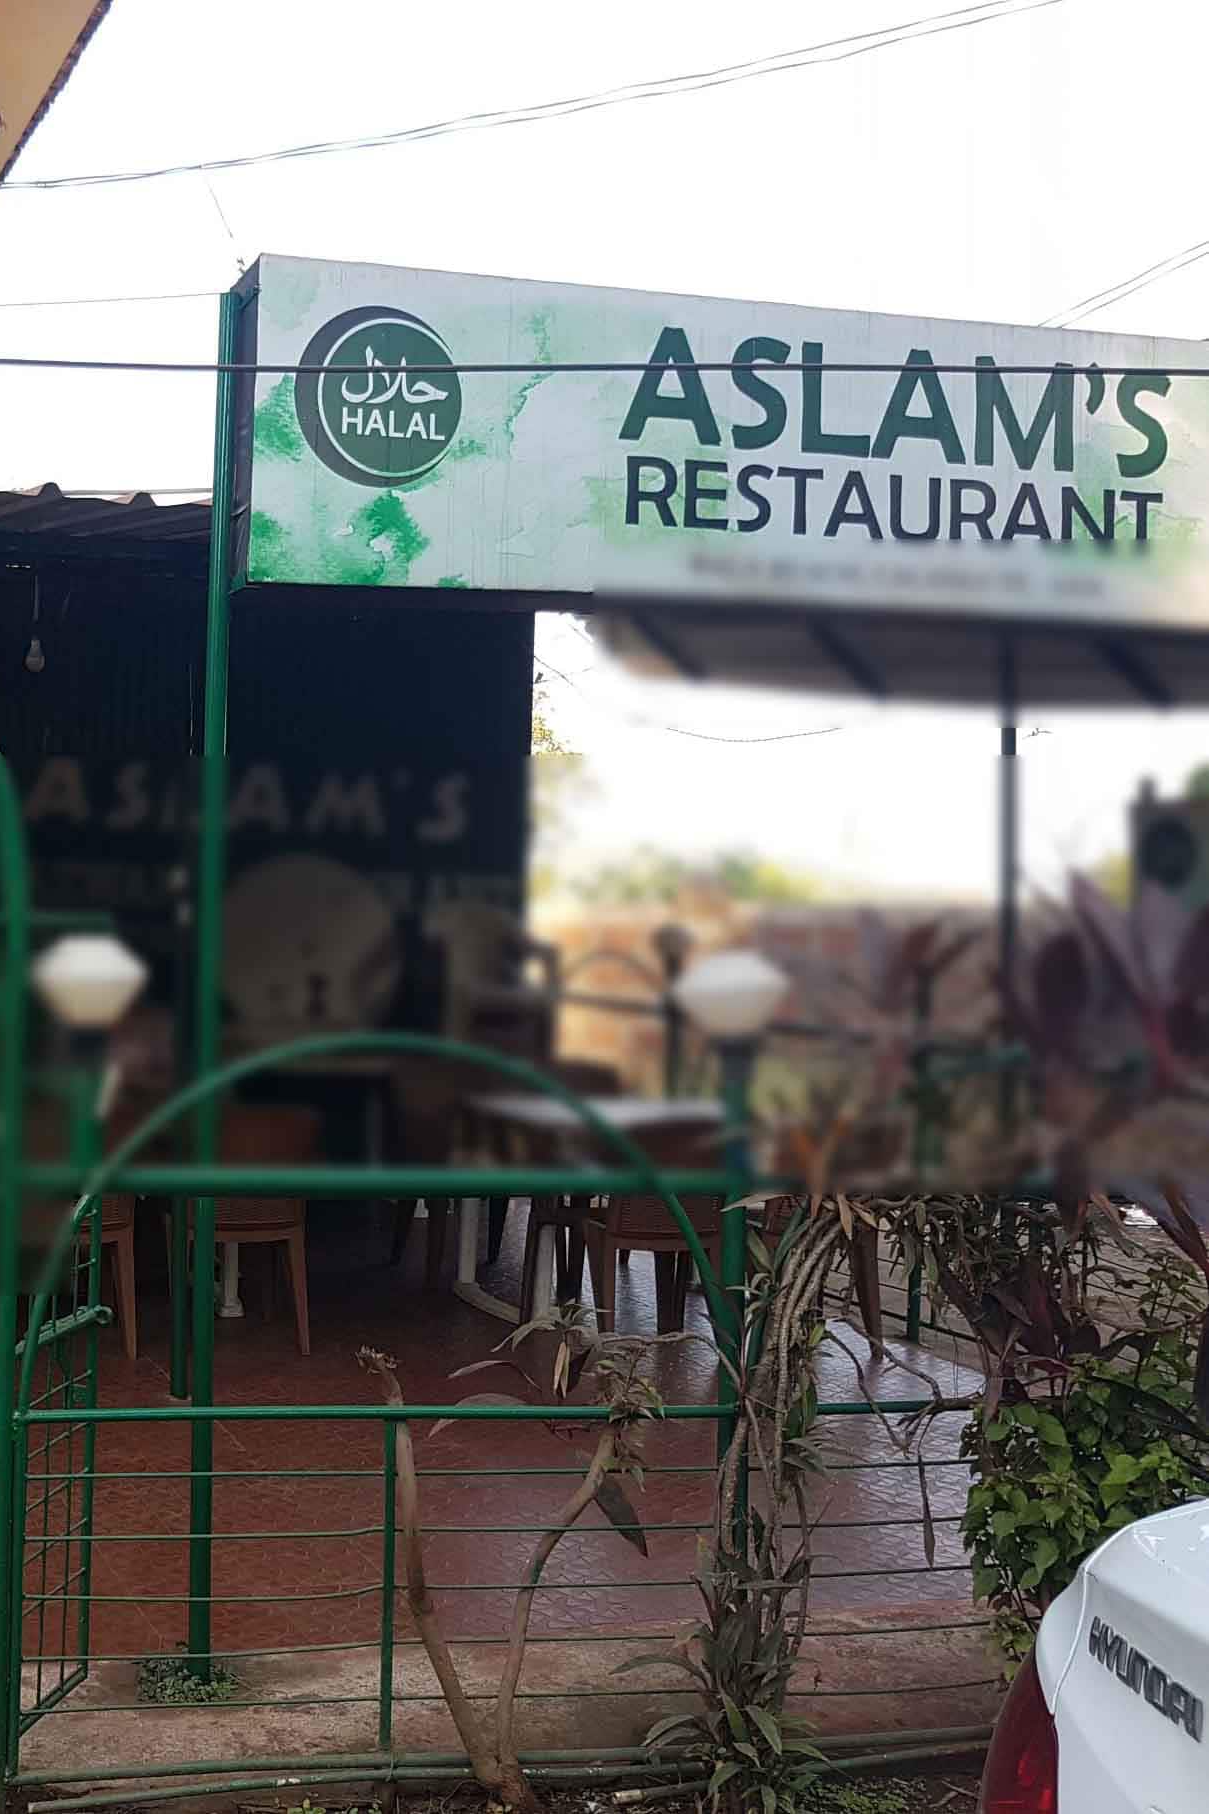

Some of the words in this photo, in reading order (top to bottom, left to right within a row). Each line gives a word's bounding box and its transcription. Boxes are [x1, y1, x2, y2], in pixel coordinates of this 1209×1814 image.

[341, 345, 449, 404] حلال
[618, 326, 1172, 478] ASLAM'S
[341, 406, 446, 441] HALAL
[624, 455, 1164, 543] RESTAURANT
[1088, 1615, 1203, 1743] HYUNDAI
